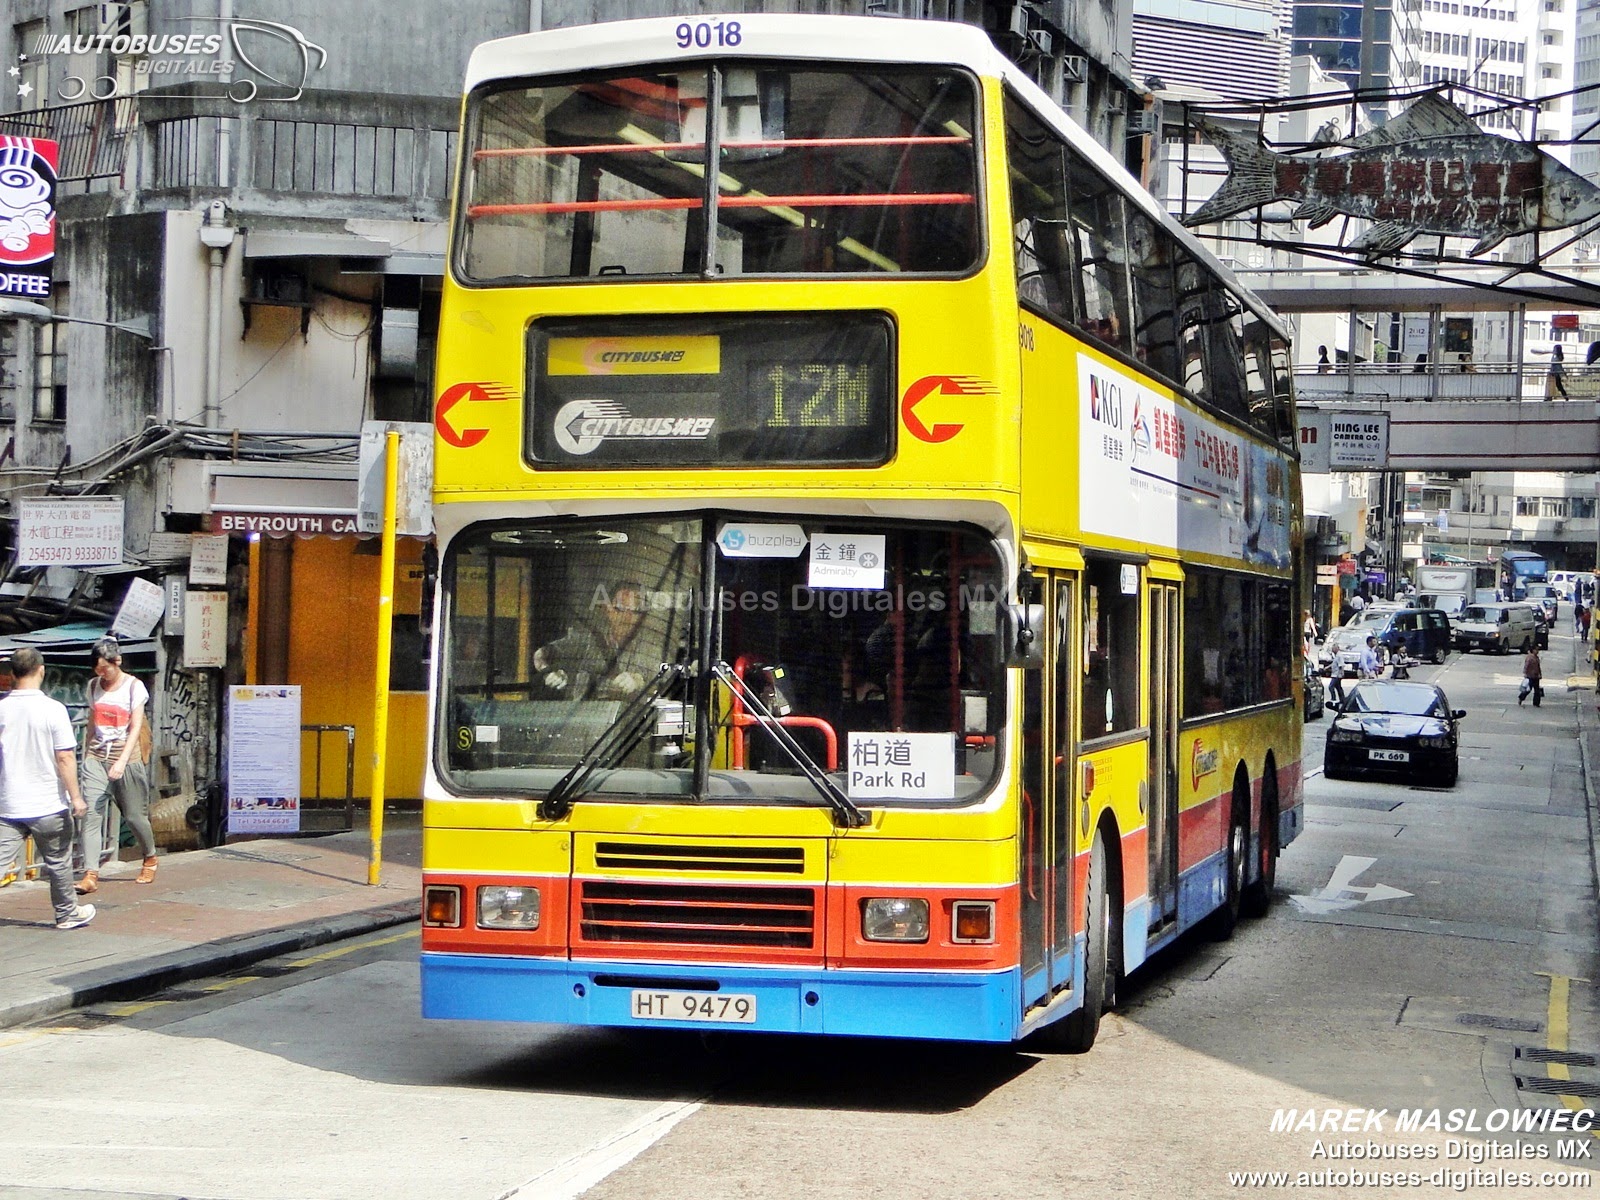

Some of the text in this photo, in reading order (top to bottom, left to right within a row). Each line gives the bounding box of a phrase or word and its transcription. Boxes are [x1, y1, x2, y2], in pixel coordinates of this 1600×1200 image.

[676, 22, 742, 48] 9018
[766, 363, 869, 428] 12M
[1101, 378, 1123, 431] KGI
[1333, 433, 1364, 441] CAMERA
[1334, 423, 1380, 433] HING LEE
[221, 515, 323, 532] BEYROUTH
[331, 518, 358, 533] CA
[748, 533, 802, 547] buzplay
[28, 547, 72, 561] 25453473
[75, 547, 118, 560] 93338715
[815, 542, 857, 562] 金鐘
[813, 566, 858, 578] Admiralty
[852, 738, 912, 768] 柏道
[1373, 751, 1405, 761] PK 669
[852, 771, 926, 789] Park Rd
[637, 993, 750, 1019] HT 9479
